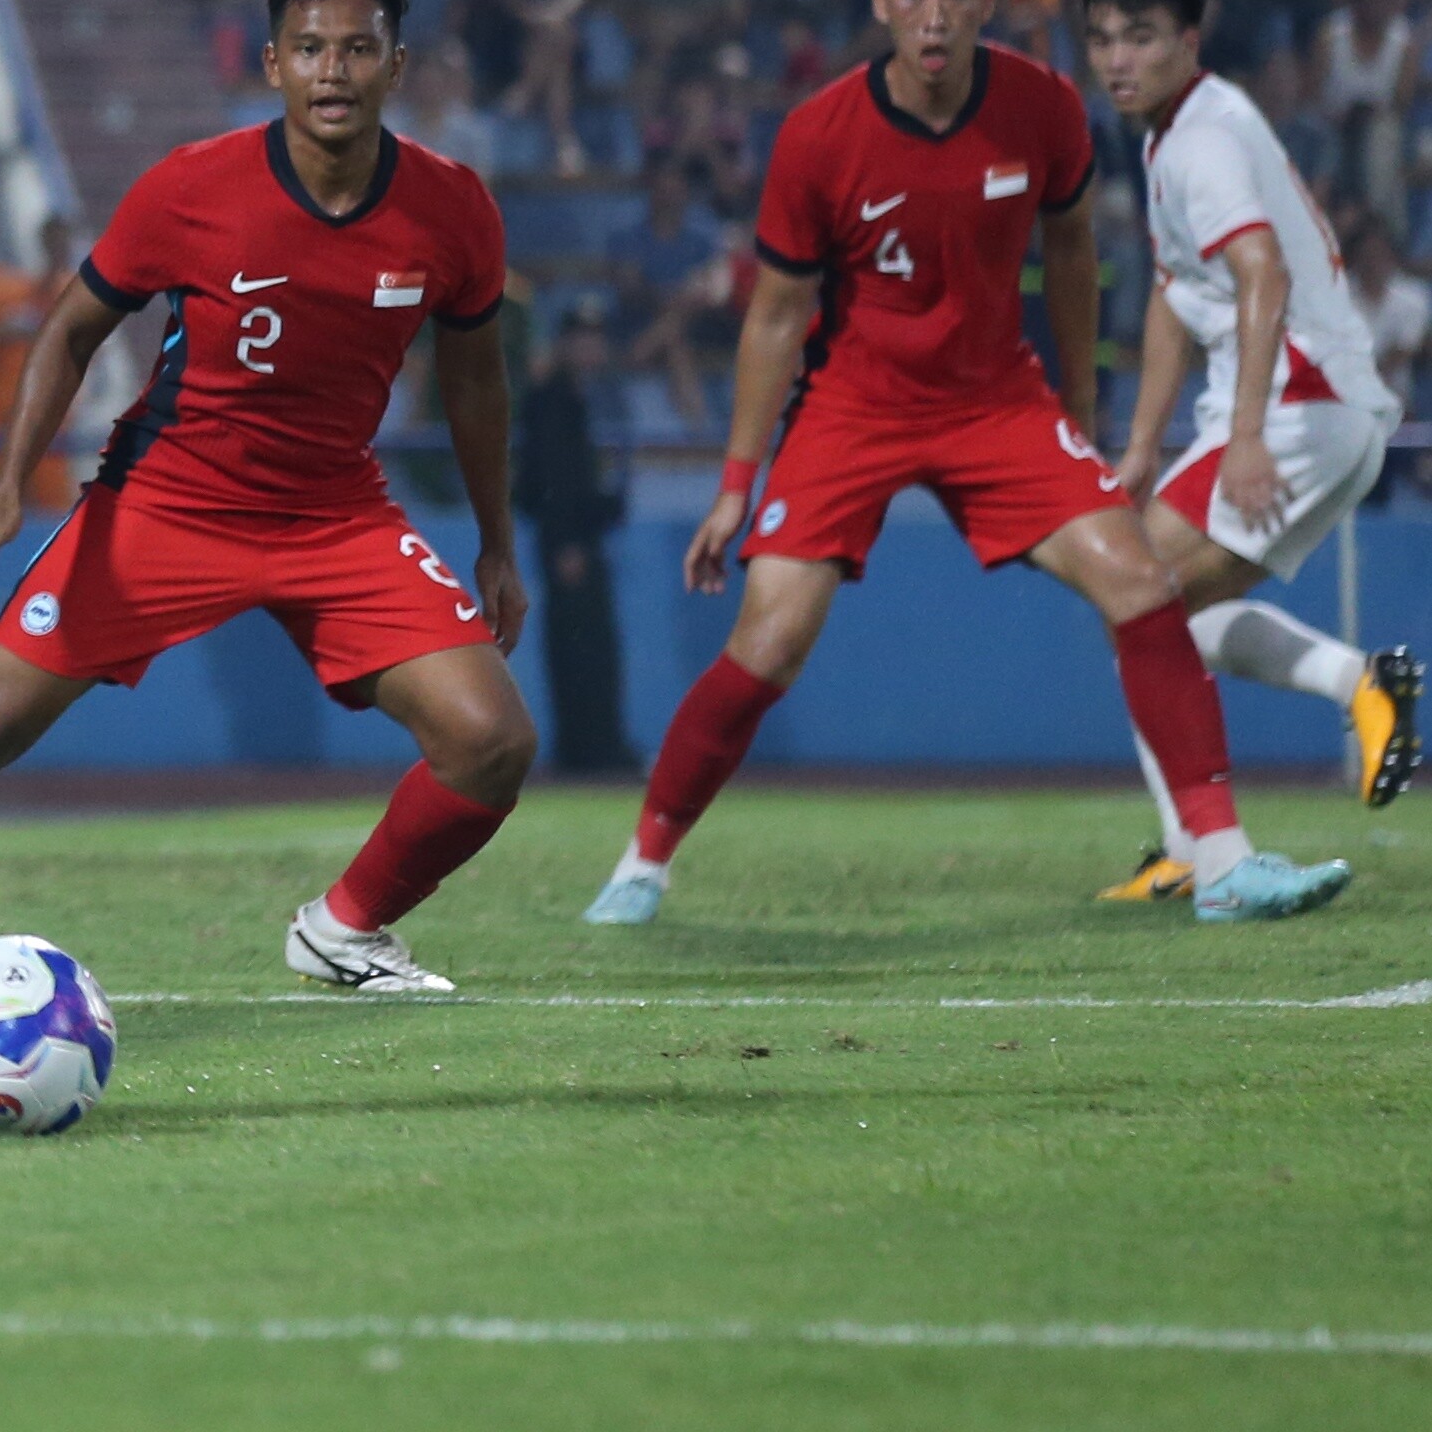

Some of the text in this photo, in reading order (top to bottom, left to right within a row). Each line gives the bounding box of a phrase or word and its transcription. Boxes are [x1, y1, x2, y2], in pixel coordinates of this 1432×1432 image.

[875, 228, 915, 282] 4
[236, 306, 283, 374] 2
[398, 532, 461, 589] 2
